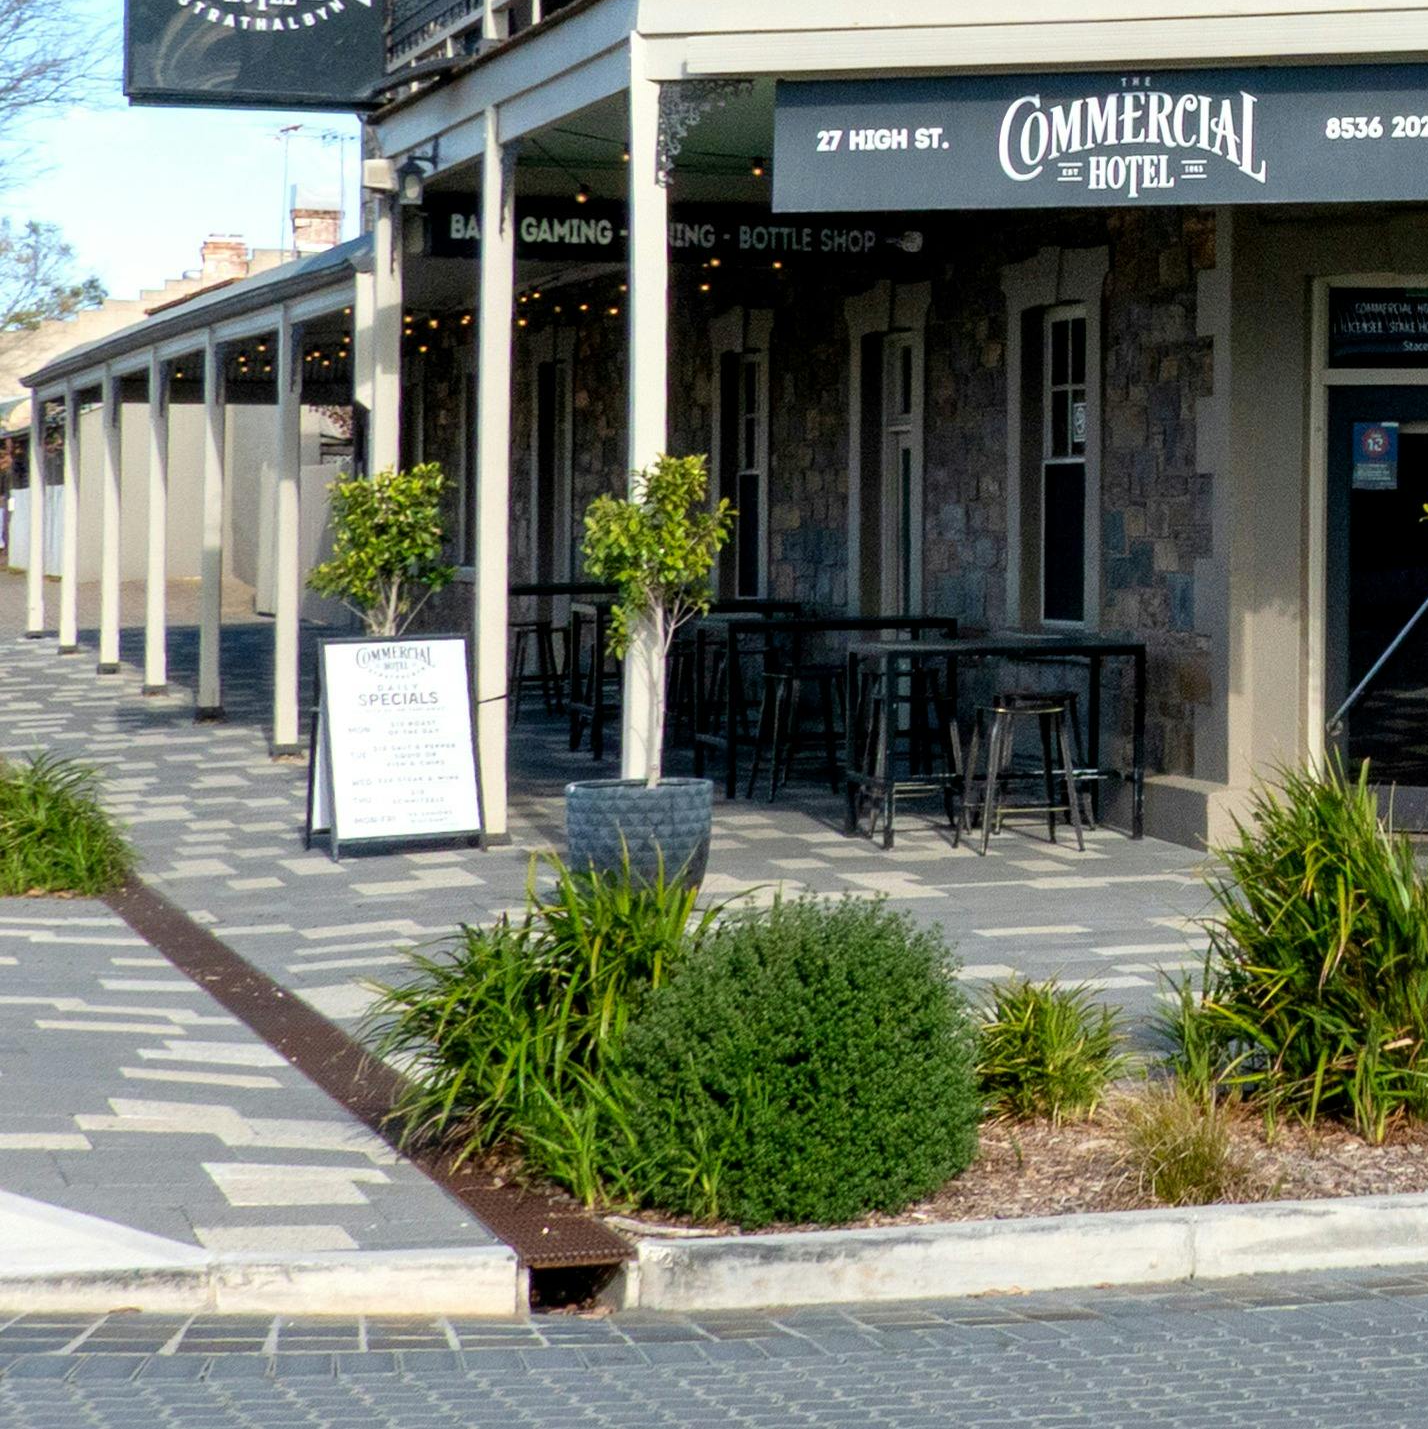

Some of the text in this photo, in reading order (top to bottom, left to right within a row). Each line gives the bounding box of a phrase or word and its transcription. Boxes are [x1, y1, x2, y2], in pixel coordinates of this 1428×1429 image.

[1120, 77, 1152, 87] THE
[816, 127, 950, 152] 27 HIGH ST.
[999, 90, 1266, 184] COMMERCIAL
[1325, 116, 1384, 140] 8536
[1088, 154, 1175, 198] HOTEL
[450, 213, 481, 240] BA
[520, 216, 613, 245] GAMING
[739, 225, 812, 252] BOTTLE
[820, 228, 876, 252] SHOP
[1355, 302, 1412, 314] COMMERCIAL
[355, 646, 436, 668] COMMERCIAL
[358, 691, 439, 706] SPECIALS
